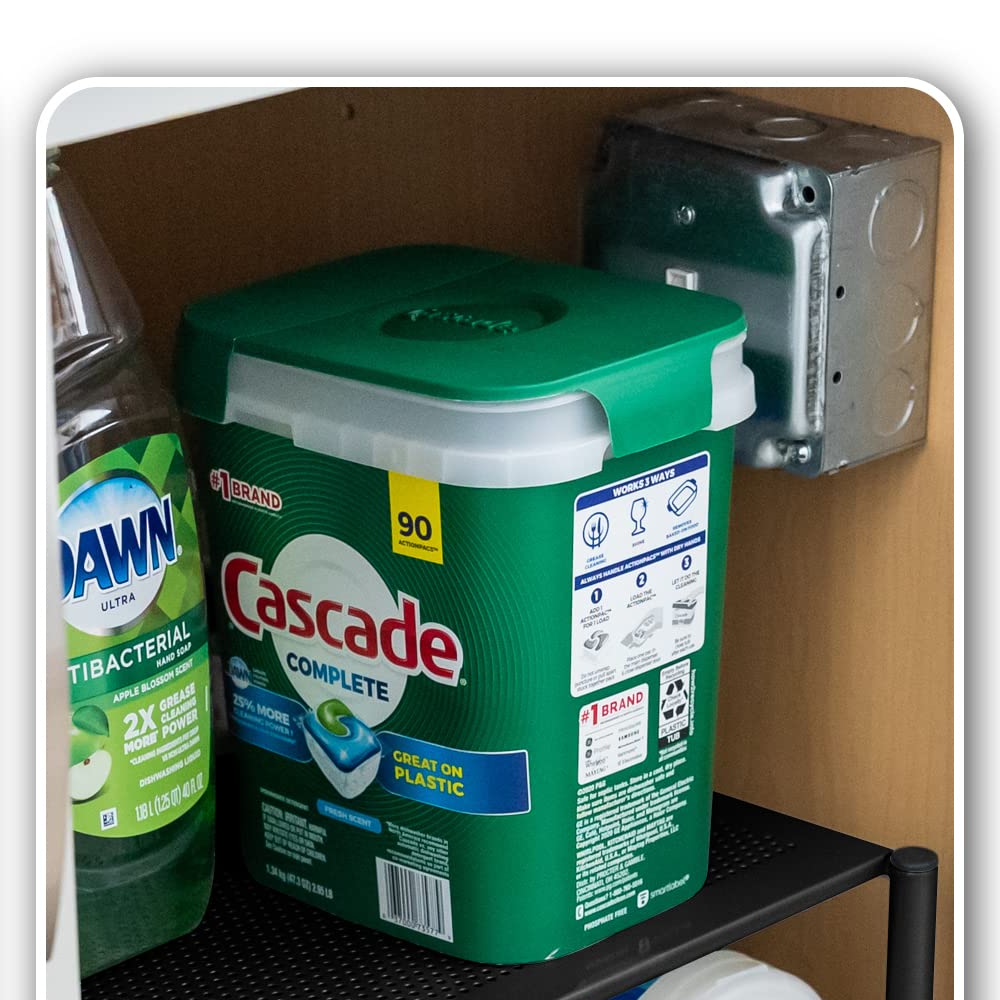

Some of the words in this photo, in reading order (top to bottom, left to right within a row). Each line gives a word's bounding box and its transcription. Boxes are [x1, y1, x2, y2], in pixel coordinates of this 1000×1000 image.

[210, 469, 231, 501] #1
[231, 479, 282, 510] BRAND
[613, 480, 643, 497] WORKS
[644, 477, 649, 486] 3
[650, 468, 675, 484] WAYS
[398, 511, 433, 541] 90
[580, 572, 601, 585] ALWAYS
[603, 564, 623, 577] HANDLE
[101, 592, 136, 611] ULTRA
[589, 606, 599, 614] ADD
[630, 592, 642, 600] LOAD
[222, 554, 462, 684] Cascade
[596, 615, 609, 624] LOAD
[156, 653, 175, 668] HAND
[177, 643, 192, 658] SOAP
[113, 685, 139, 703] APPLE
[141, 669, 174, 693] BLOSSOM
[175, 659, 193, 676] SCENT
[286, 652, 389, 702] COMPLETE
[160, 683, 196, 711] GREASE
[581, 703, 597, 729] #1
[601, 690, 643, 717] BRAND
[123, 704, 158, 740] 2X
[162, 708, 198, 739] POWER
[256, 703, 290, 726] MORE
[661, 719, 686, 735] PLASTIC
[667, 731, 680, 743] TUB
[139, 761, 184, 788] DISHWASHING
[393, 750, 437, 772] GREAT
[441, 763, 463, 778] ON
[394, 766, 465, 797] PLASTIC
[324, 806, 347, 821] FRESH
[349, 813, 372, 828] SCENT
